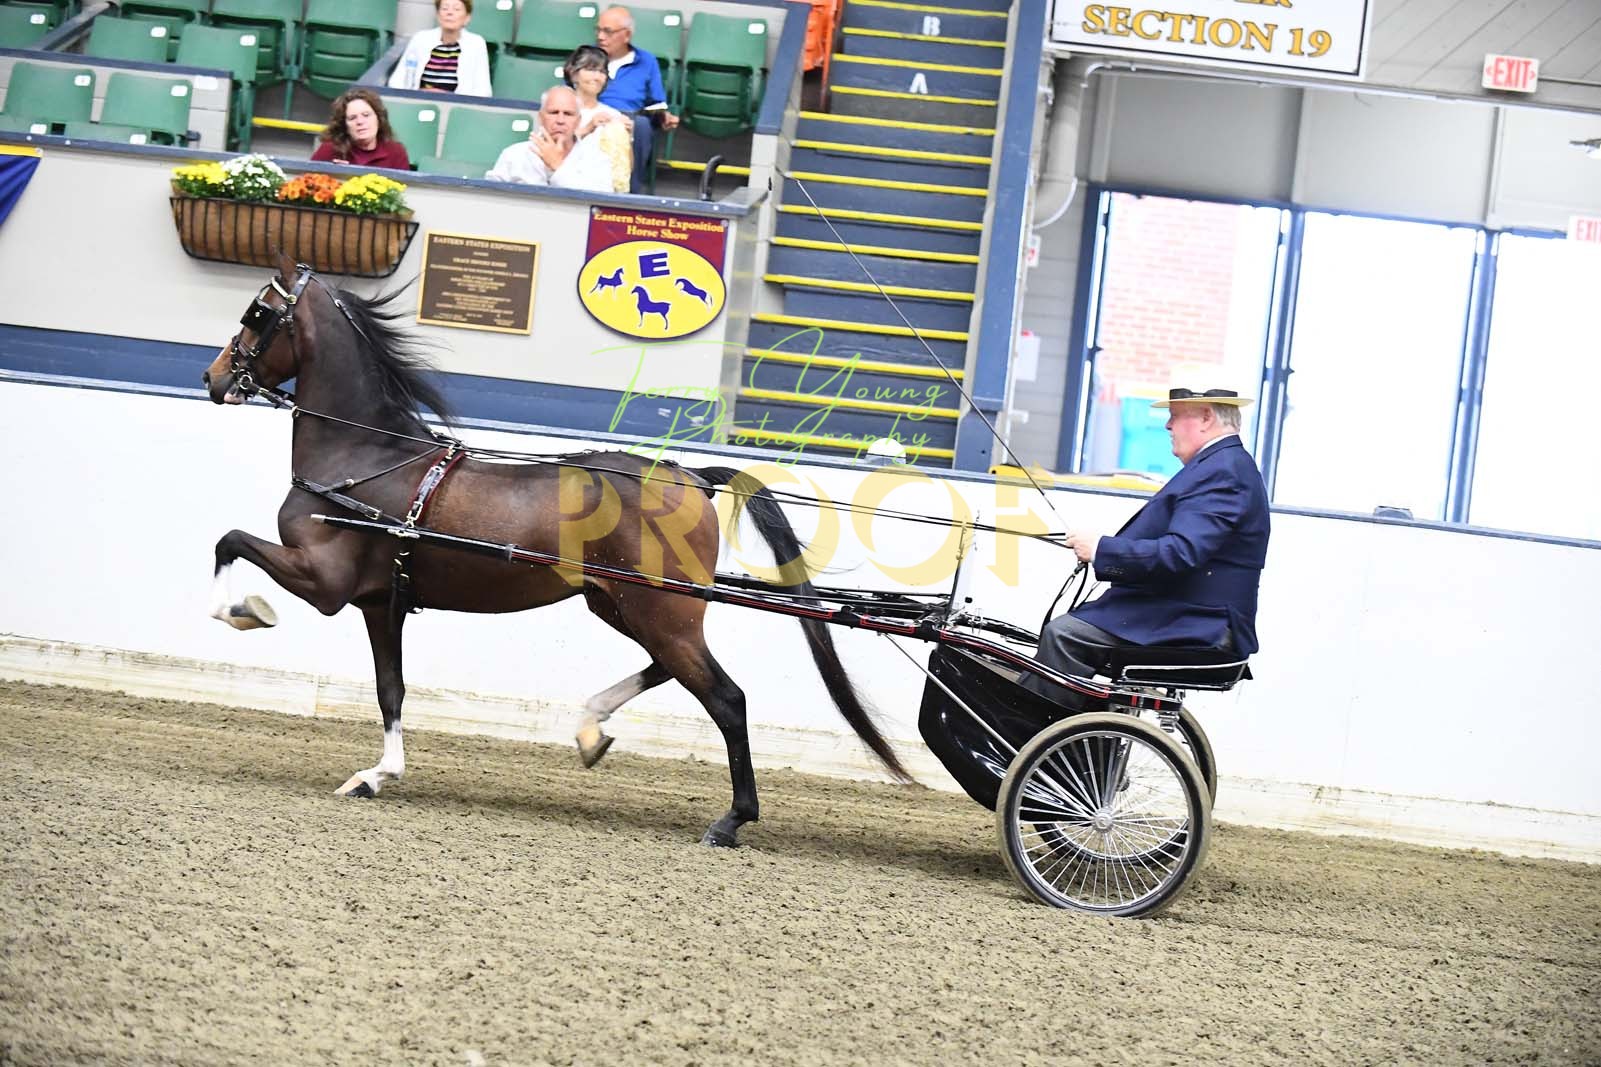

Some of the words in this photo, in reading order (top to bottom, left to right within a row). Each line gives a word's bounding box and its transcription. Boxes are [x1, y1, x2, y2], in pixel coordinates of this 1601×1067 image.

[922, 15, 941, 36] B
[1082, 4, 1278, 53] SECTION
[1287, 27, 1333, 58] 19
[909, 72, 929, 95] A
[1491, 56, 1532, 88] EXIT
[594, 212, 634, 224] Eastern
[635, 214, 667, 227] States
[668, 217, 725, 233] Exposition
[626, 225, 659, 237] Horse
[660, 229, 689, 240] Show
[638, 252, 671, 279] E
